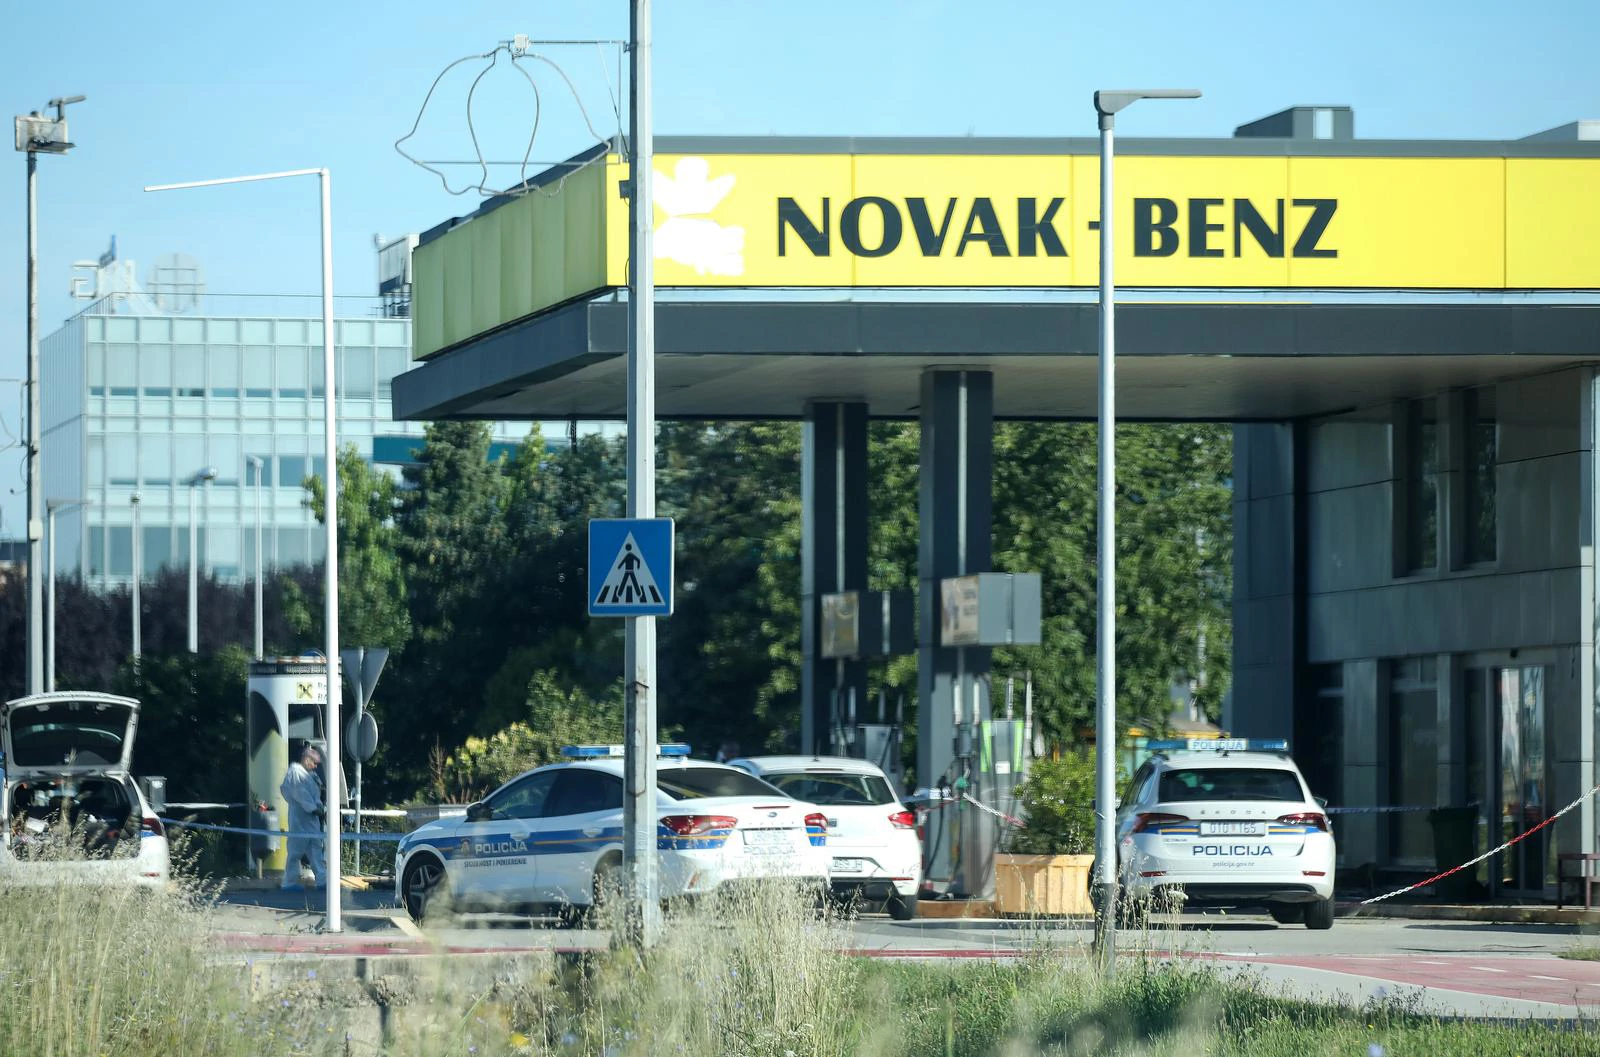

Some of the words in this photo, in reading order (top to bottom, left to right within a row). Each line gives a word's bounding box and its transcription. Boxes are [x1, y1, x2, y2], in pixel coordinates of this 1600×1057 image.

[778, 196, 1069, 259] NOVAK
[1133, 197, 1339, 259] BENZ
[1193, 741, 1243, 750] POLICIJA
[474, 840, 528, 855] POLICIJA
[1192, 845, 1273, 856] POLICIJA
